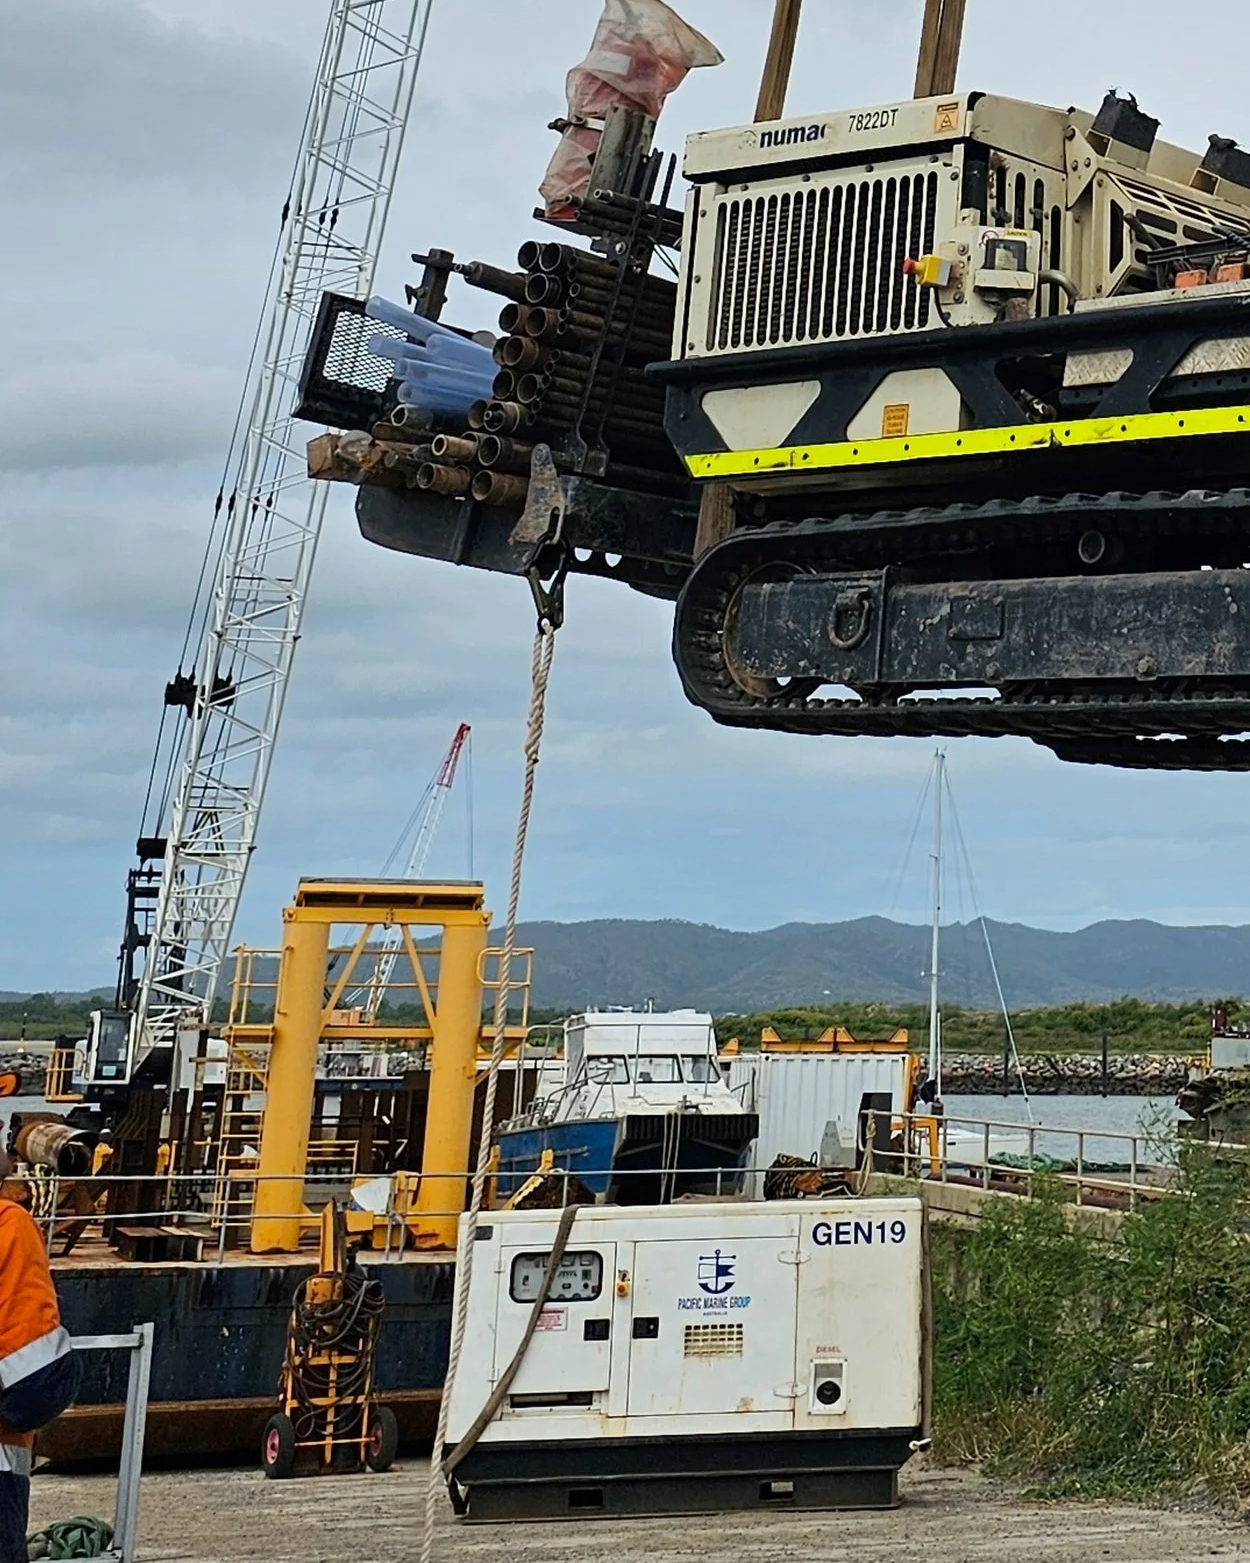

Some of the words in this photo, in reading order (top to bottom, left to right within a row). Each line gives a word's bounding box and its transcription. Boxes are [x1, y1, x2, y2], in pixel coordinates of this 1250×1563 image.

[849, 108, 899, 133] 7822DT
[812, 1220, 906, 1246] GEN19
[678, 1297, 702, 1310] PACIFIC
[703, 1296, 728, 1309] MARINE
[729, 1295, 751, 1308] GROUP
